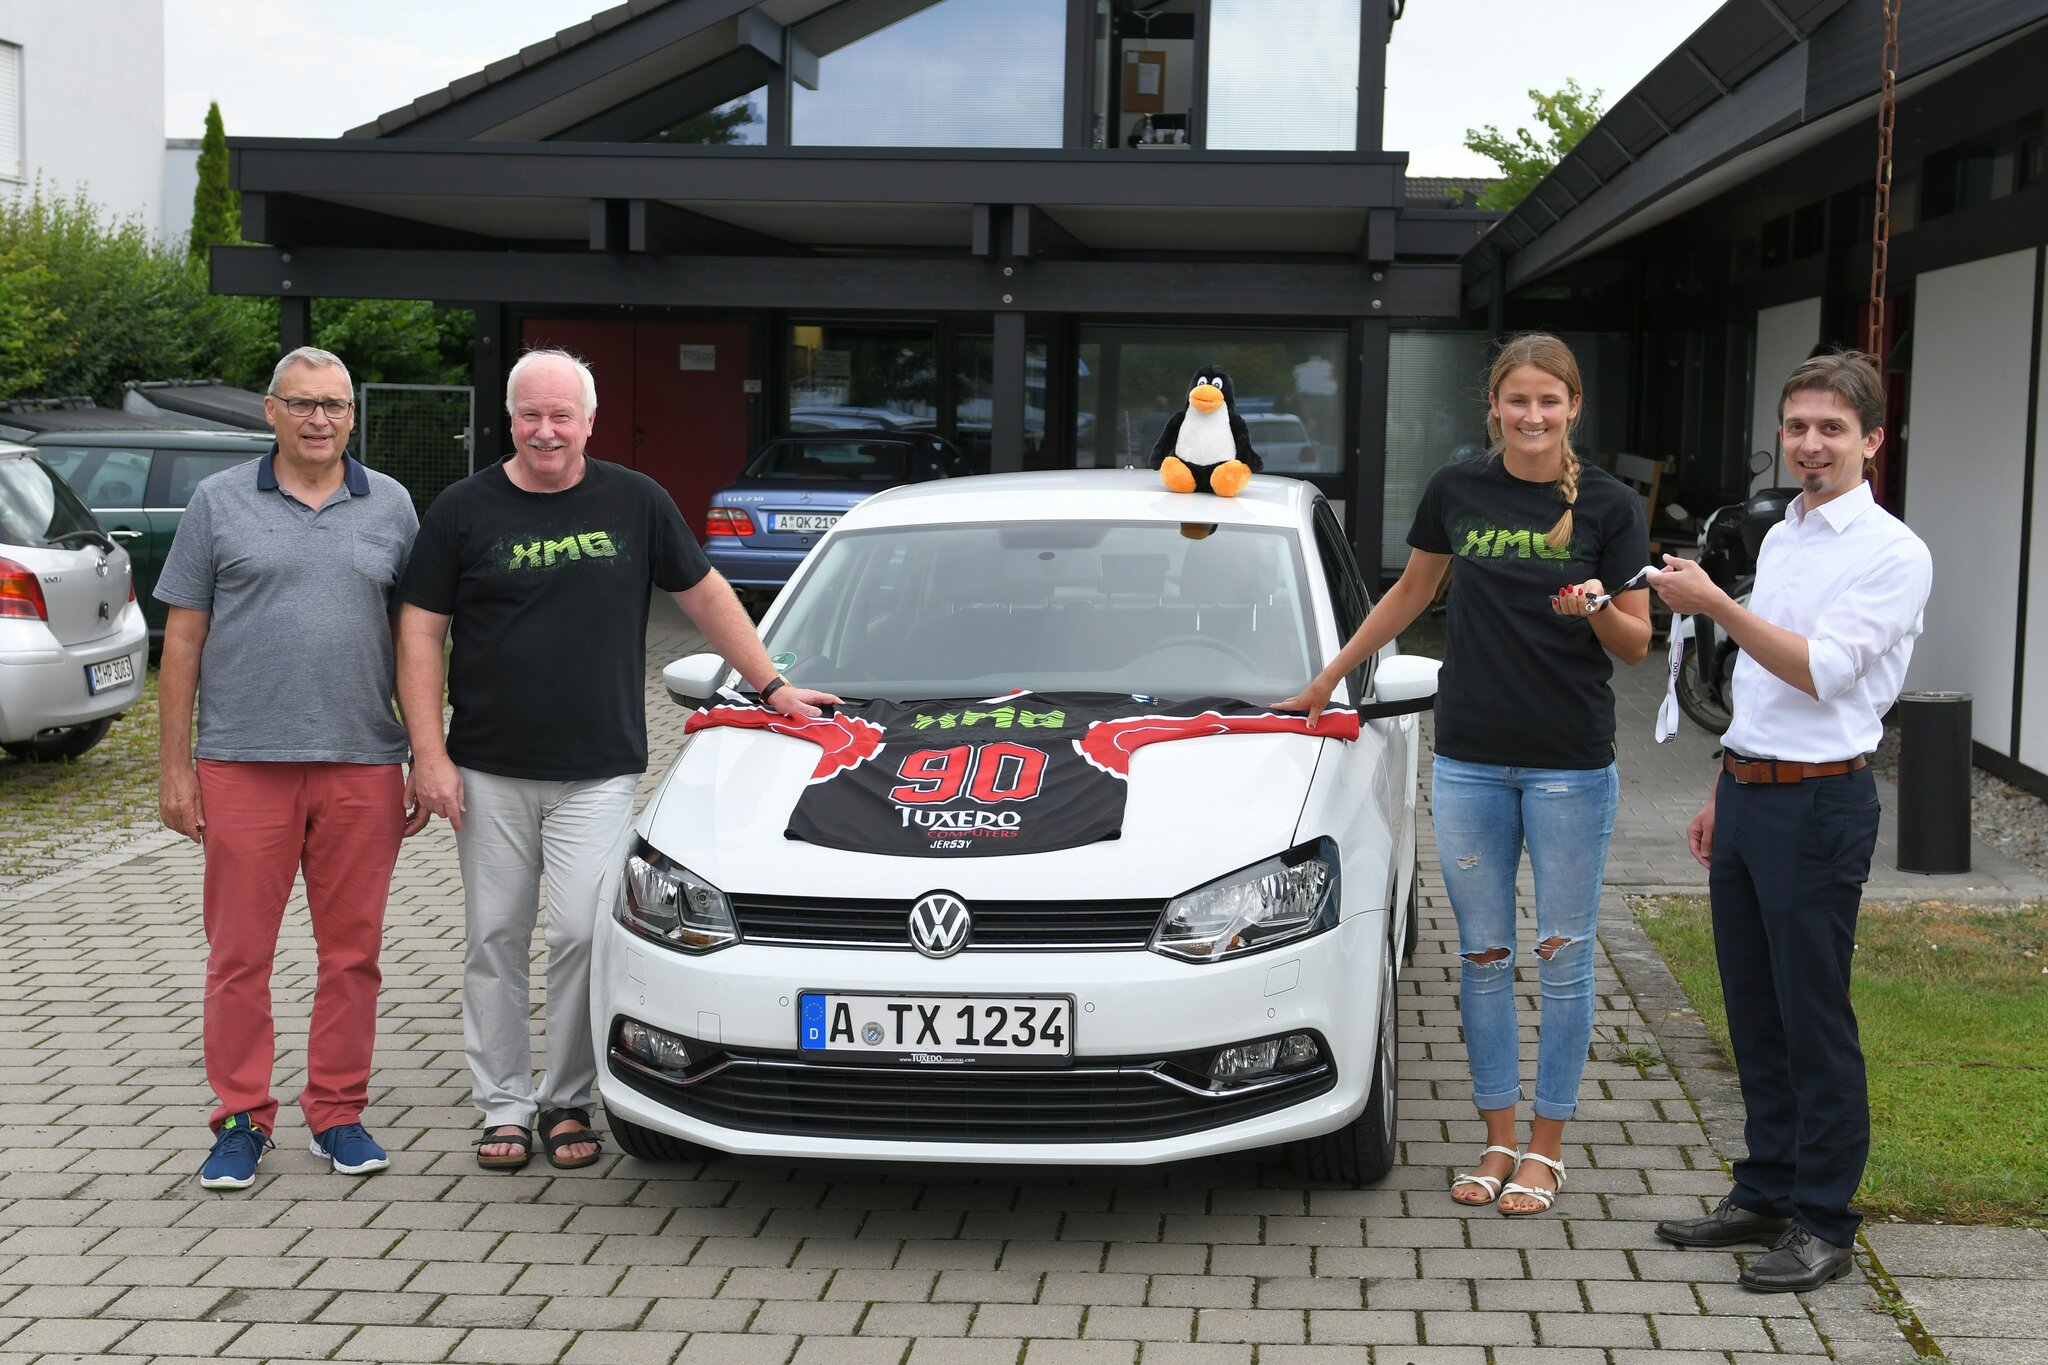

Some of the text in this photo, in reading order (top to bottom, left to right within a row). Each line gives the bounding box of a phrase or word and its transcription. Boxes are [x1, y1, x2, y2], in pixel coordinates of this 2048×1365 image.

[780, 517, 788, 528] A
[796, 517, 811, 528] QK
[508, 531, 618, 570] XMG
[888, 741, 1050, 805] 90
[895, 805, 1022, 830] TUXEDO
[927, 829, 1019, 839] COMPUTERS
[809, 1027, 819, 1040] D
[829, 1002, 855, 1044] A
[887, 1003, 941, 1045] TX
[956, 1004, 1064, 1048] 1234
